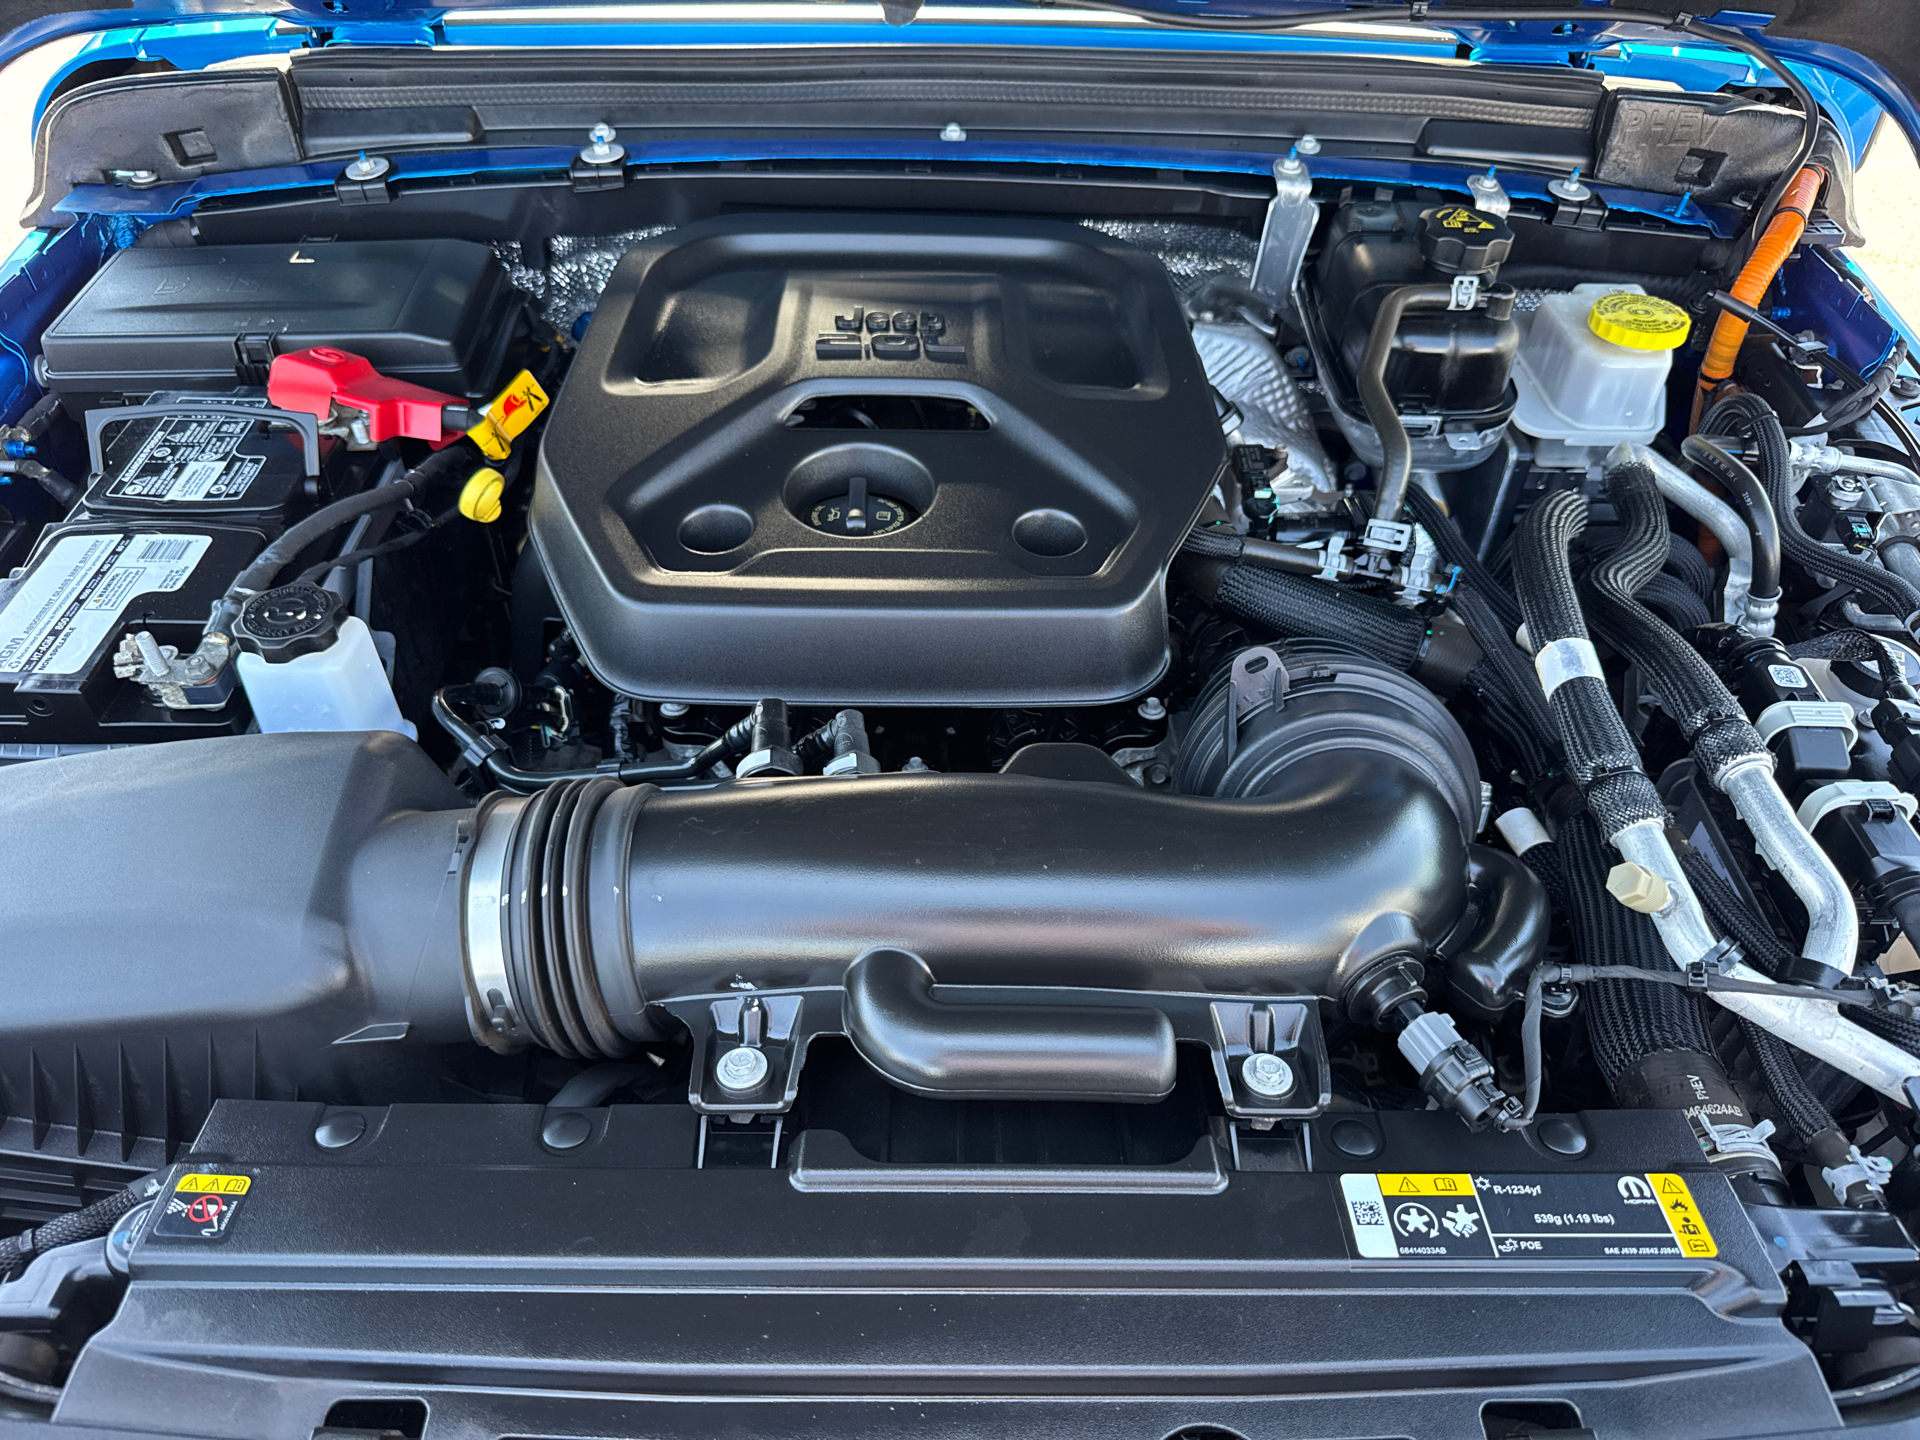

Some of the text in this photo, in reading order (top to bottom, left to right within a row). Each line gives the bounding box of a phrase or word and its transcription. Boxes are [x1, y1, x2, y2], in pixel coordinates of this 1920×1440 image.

[1612, 108, 1721, 147] PHEV
[834, 305, 945, 336] Jeep
[816, 331, 967, 358] 2.0L
[24, 598, 55, 634] ABSORBENT
[52, 578, 71, 597] GLASS
[68, 565, 81, 577] MAT
[79, 540, 100, 564] BATTERY
[98, 573, 119, 598] WARNING:
[31, 636, 55, 660] H7-AGM
[55, 618, 69, 630] 850
[39, 627, 76, 670] NON-SPILLABLE
[1686, 1074, 1710, 1100] PHEV
[1493, 1185, 1542, 1196] R-1234yf
[1534, 1213, 1615, 1226] 539g (1.19 lbs)
[1399, 1246, 1447, 1255] 68414033AB
[1520, 1241, 1543, 1250] POE
[1604, 1247, 1620, 1255] SAE
